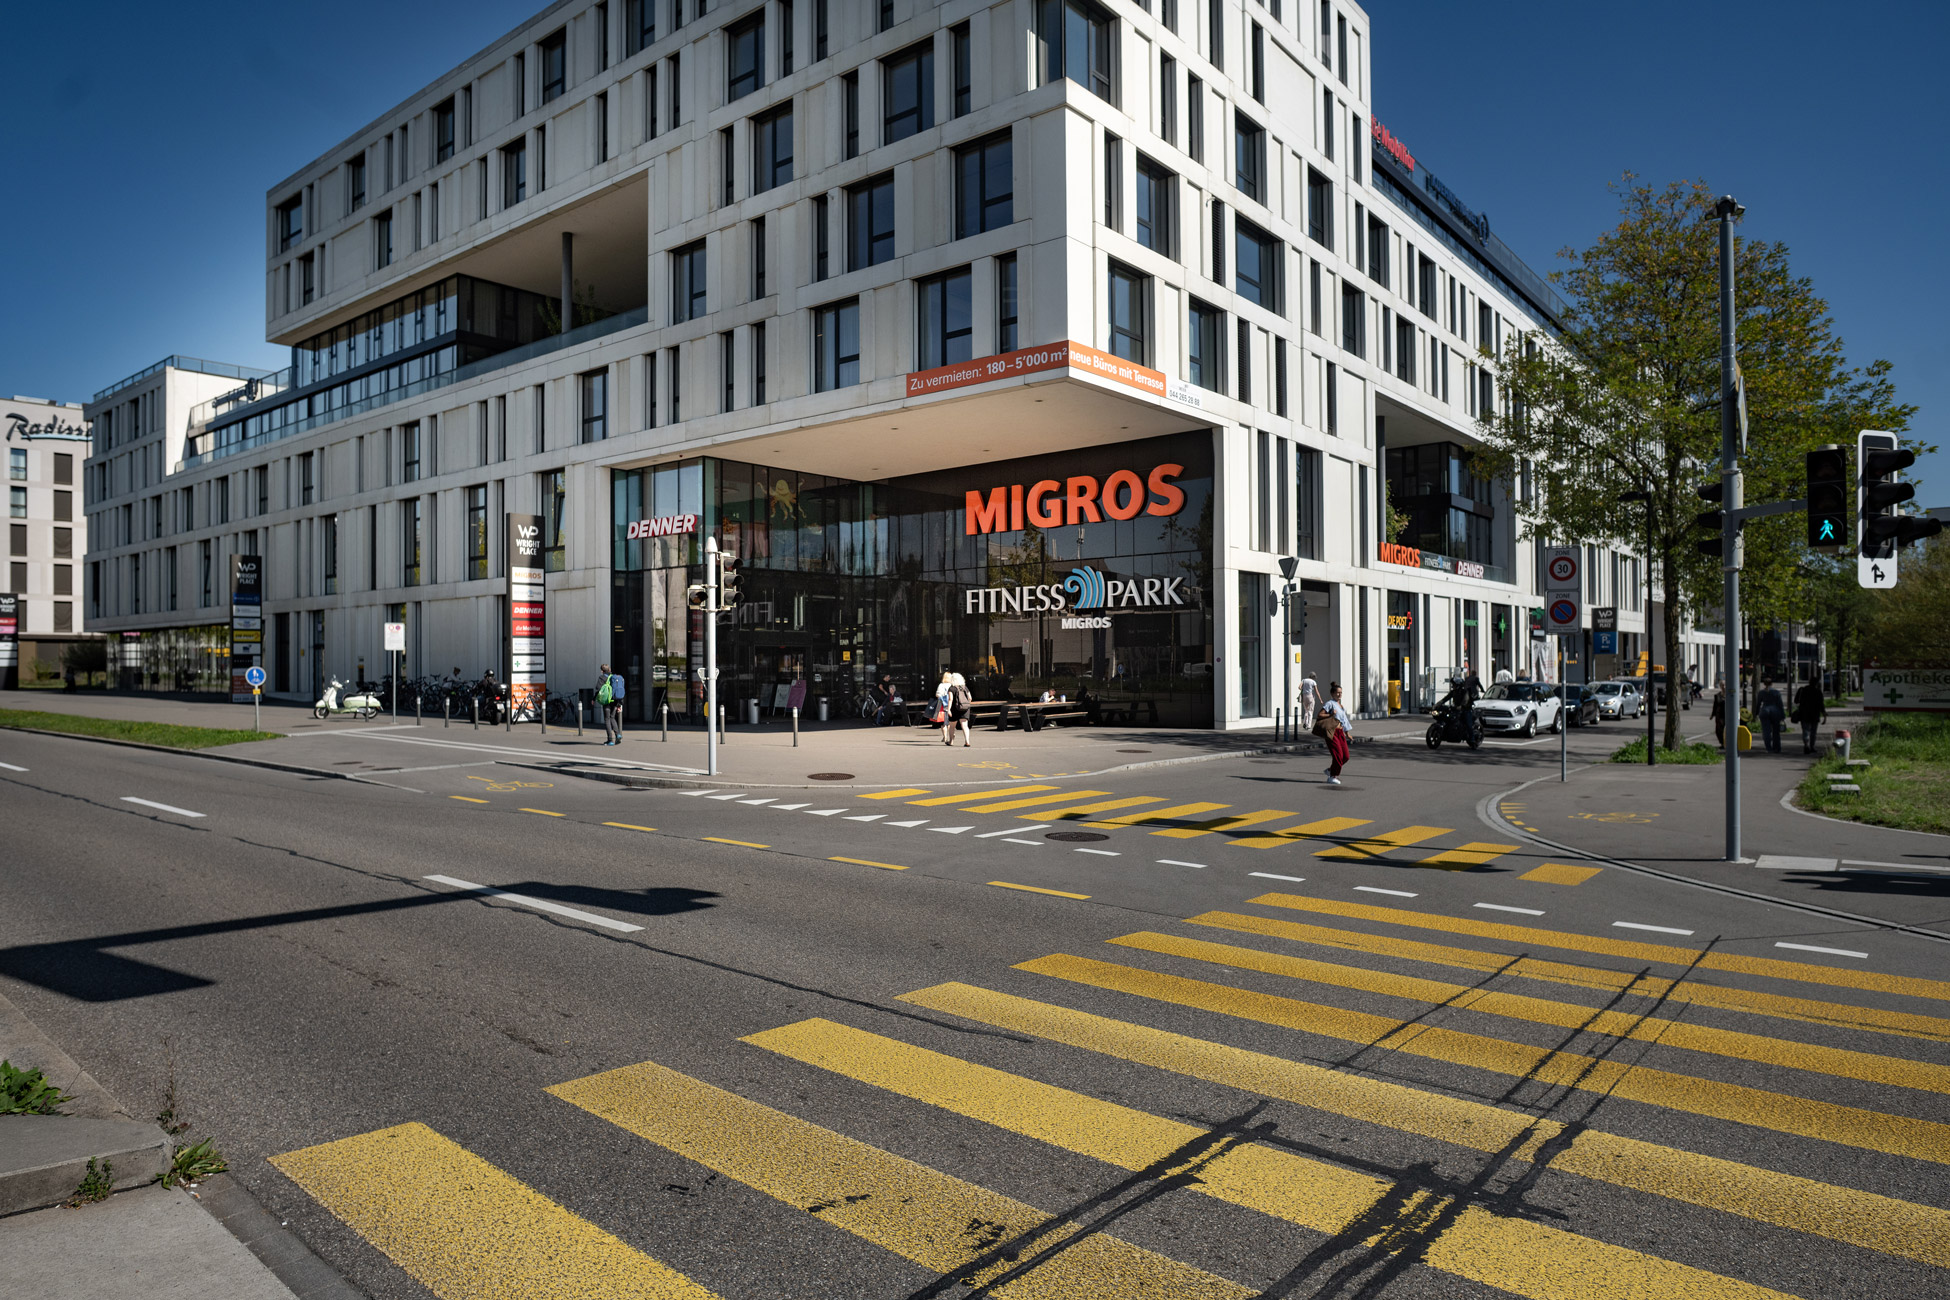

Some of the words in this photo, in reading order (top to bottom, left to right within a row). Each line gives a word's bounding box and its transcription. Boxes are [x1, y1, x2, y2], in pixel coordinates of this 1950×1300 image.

[1382, 124, 1415, 172] Mobiliar
[911, 378, 923, 390] Zu
[926, 367, 982, 387] vermieten:
[1070, 350, 1092, 366] neue
[1093, 355, 1118, 375] Büros
[1118, 367, 1133, 381] mit
[1133, 369, 1164, 391] Terrasse
[965, 463, 1185, 536] MIGROS
[626, 514, 698, 539] DENNER
[516, 538, 540, 548] WRIGHT
[519, 547, 537, 556] PLACE
[1379, 541, 1420, 568] MIGROS
[236, 572, 257, 580] WRIGHT
[515, 572, 542, 580] MIGROS
[1456, 560, 1484, 579] DENNER
[1557, 564, 1569, 574] 30
[966, 583, 1066, 614] FITNESS
[1107, 576, 1185, 608] PARK
[514, 607, 543, 615] DENNER
[1061, 616, 1113, 630] MIGROS
[1388, 615, 1396, 626] DIE
[1396, 616, 1408, 627] POST
[1870, 671, 1950, 687] Apotheke
